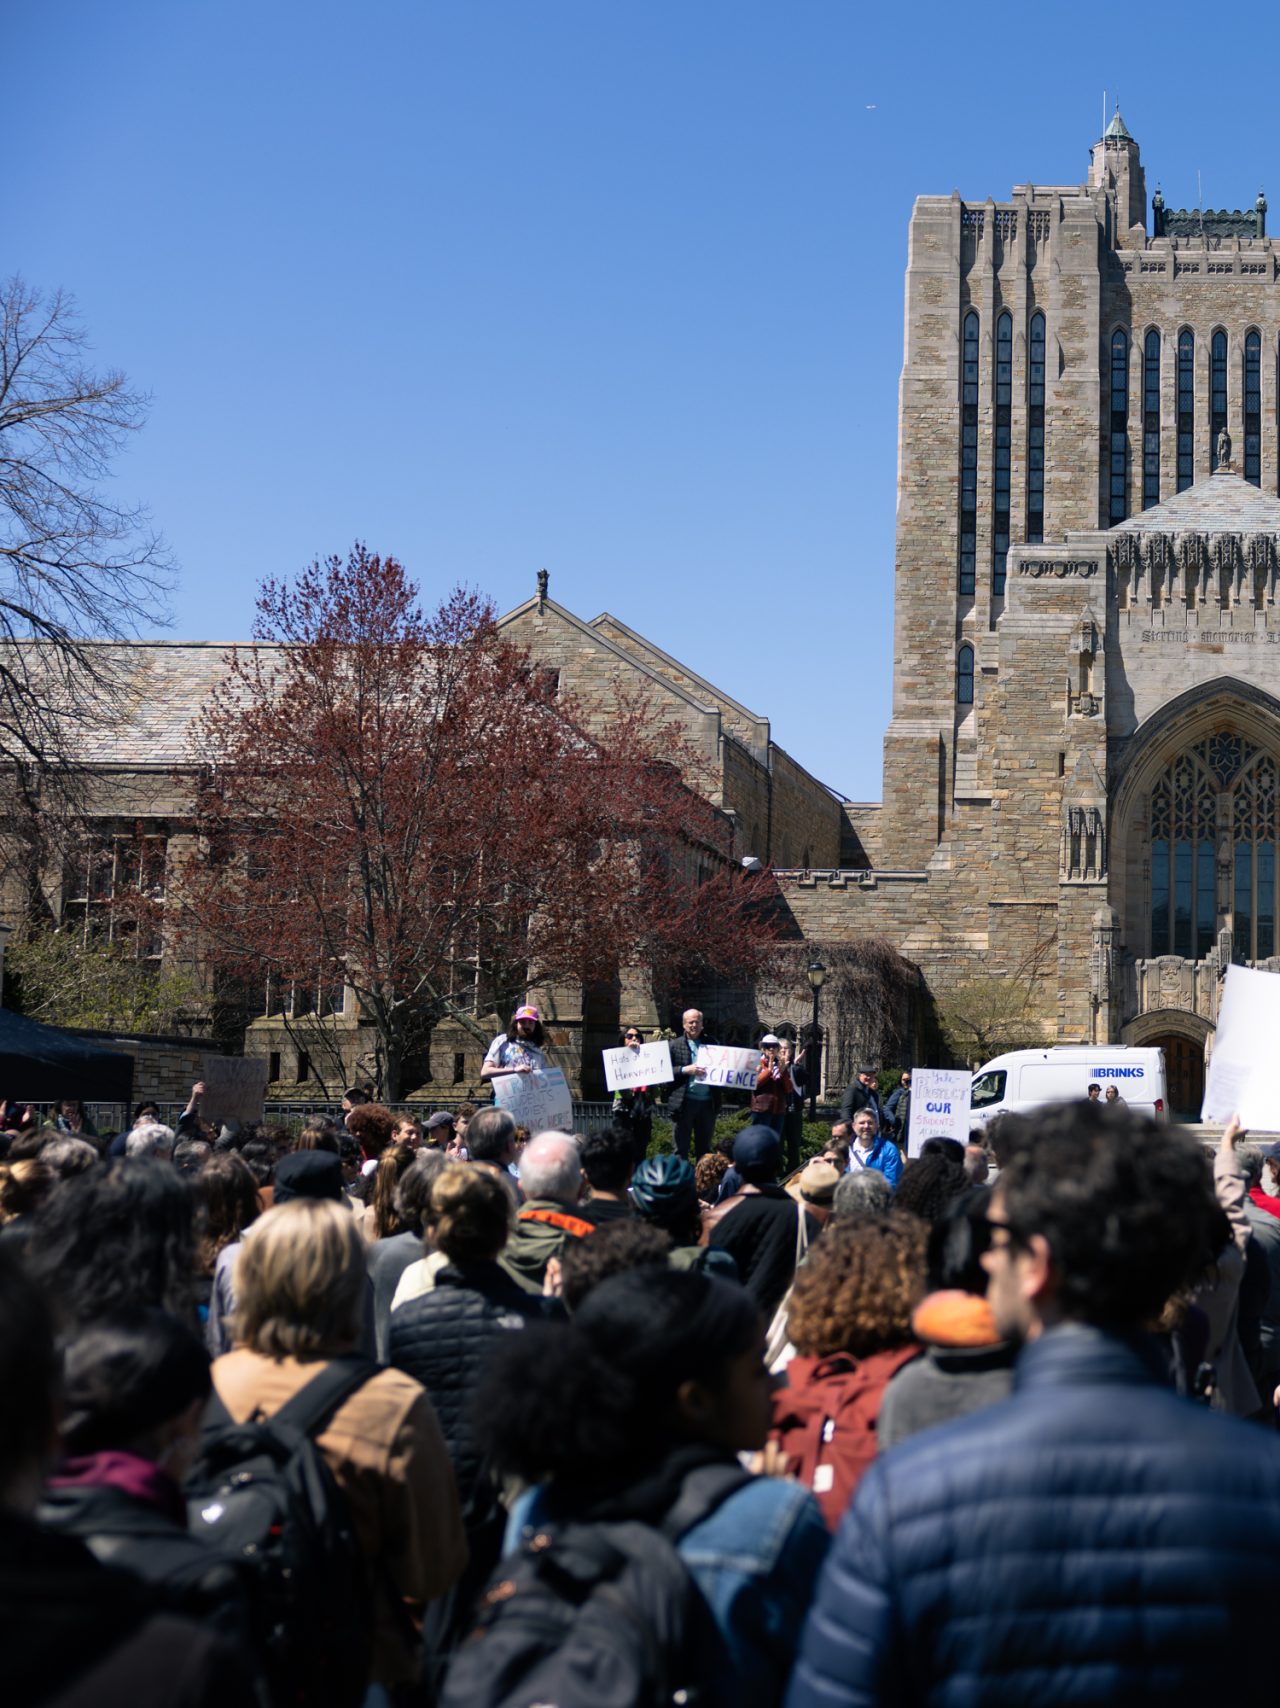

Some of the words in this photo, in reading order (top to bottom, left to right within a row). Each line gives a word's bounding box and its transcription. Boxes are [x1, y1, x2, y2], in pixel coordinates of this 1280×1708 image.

[704, 1046, 757, 1071] SAVE
[698, 1066, 757, 1087] SCIENCE
[1099, 1067, 1145, 1078] BRINKS
[926, 1102, 952, 1114] OUR
